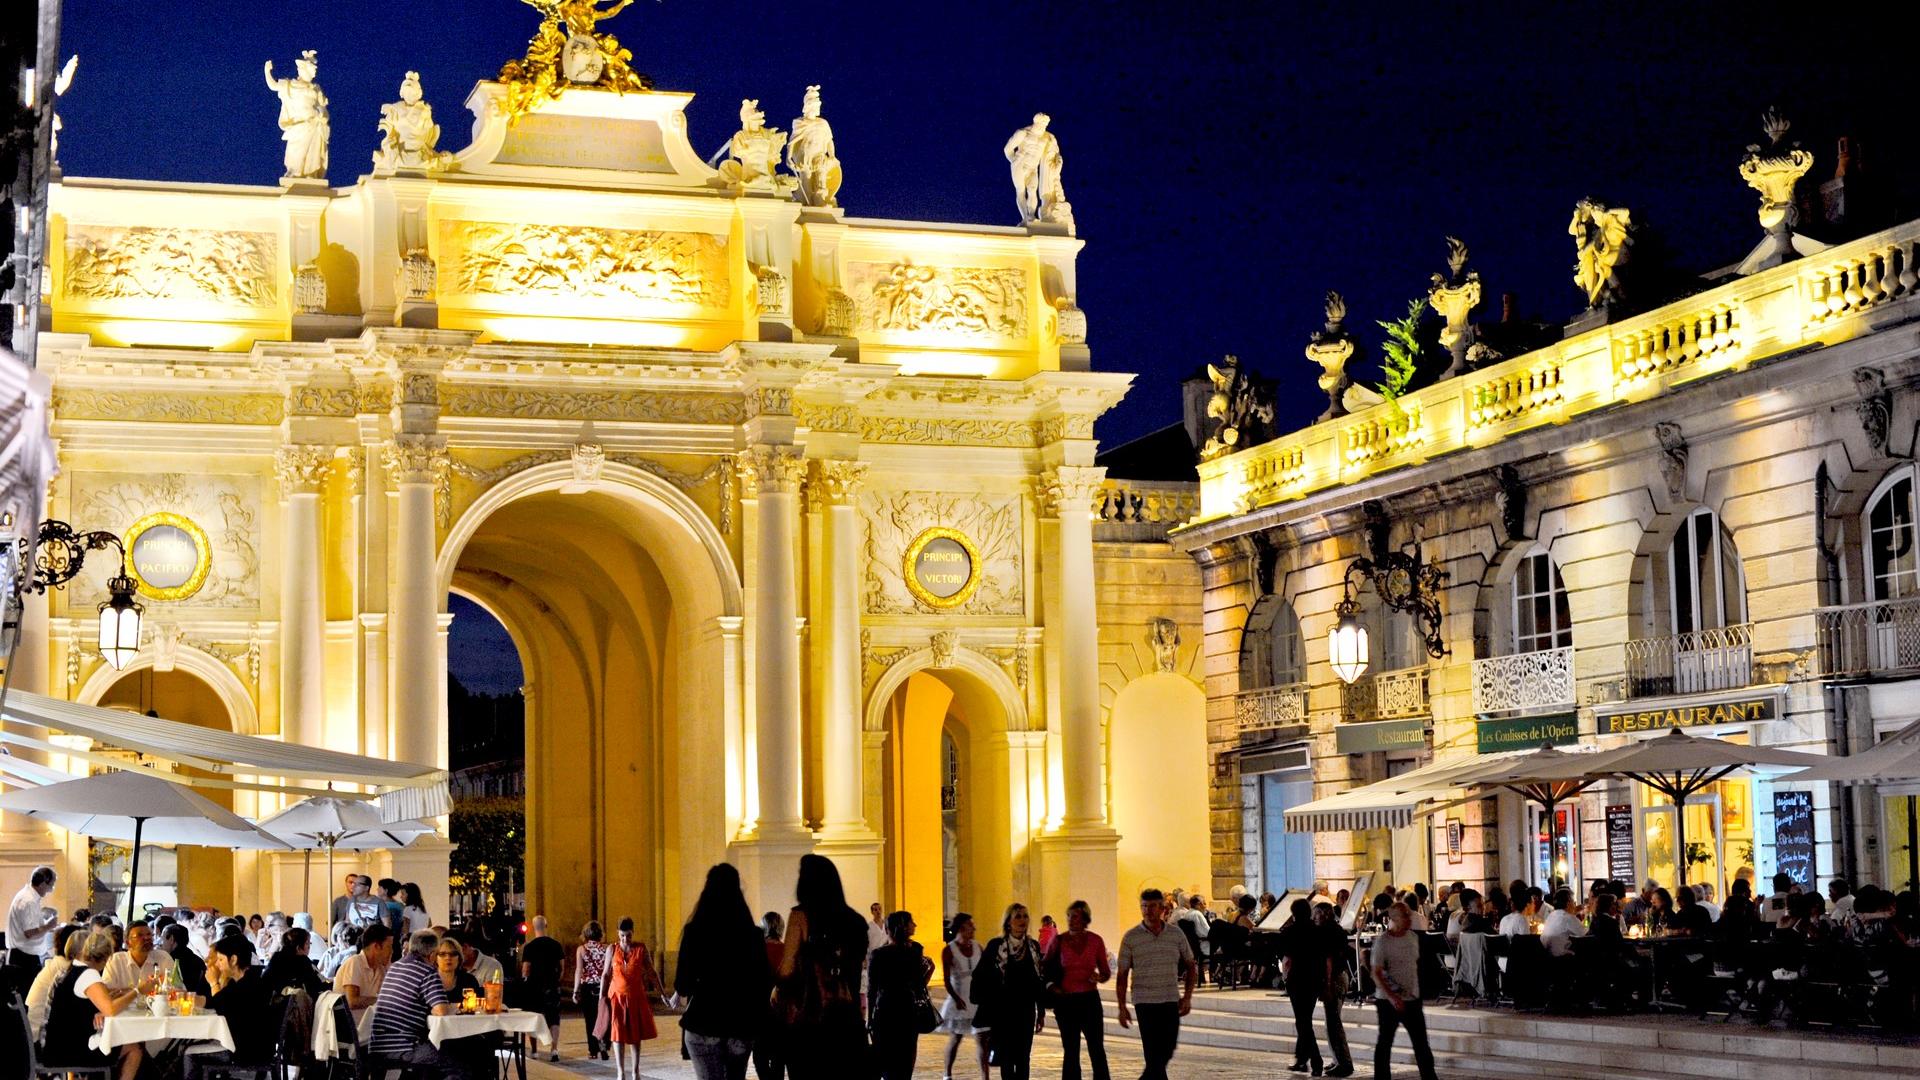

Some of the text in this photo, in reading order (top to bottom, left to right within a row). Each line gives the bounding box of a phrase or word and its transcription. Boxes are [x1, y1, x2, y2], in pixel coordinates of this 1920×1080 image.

[923, 552, 963, 562] PRINCIPI
[141, 562, 189, 574] PACIFICO
[925, 573, 962, 585] VICTORI
[1609, 701, 1765, 733] RESTAURANT
[1376, 727, 1425, 746] Restaurant
[1481, 723, 1575, 743] Les Coulisses de L'Opéra
